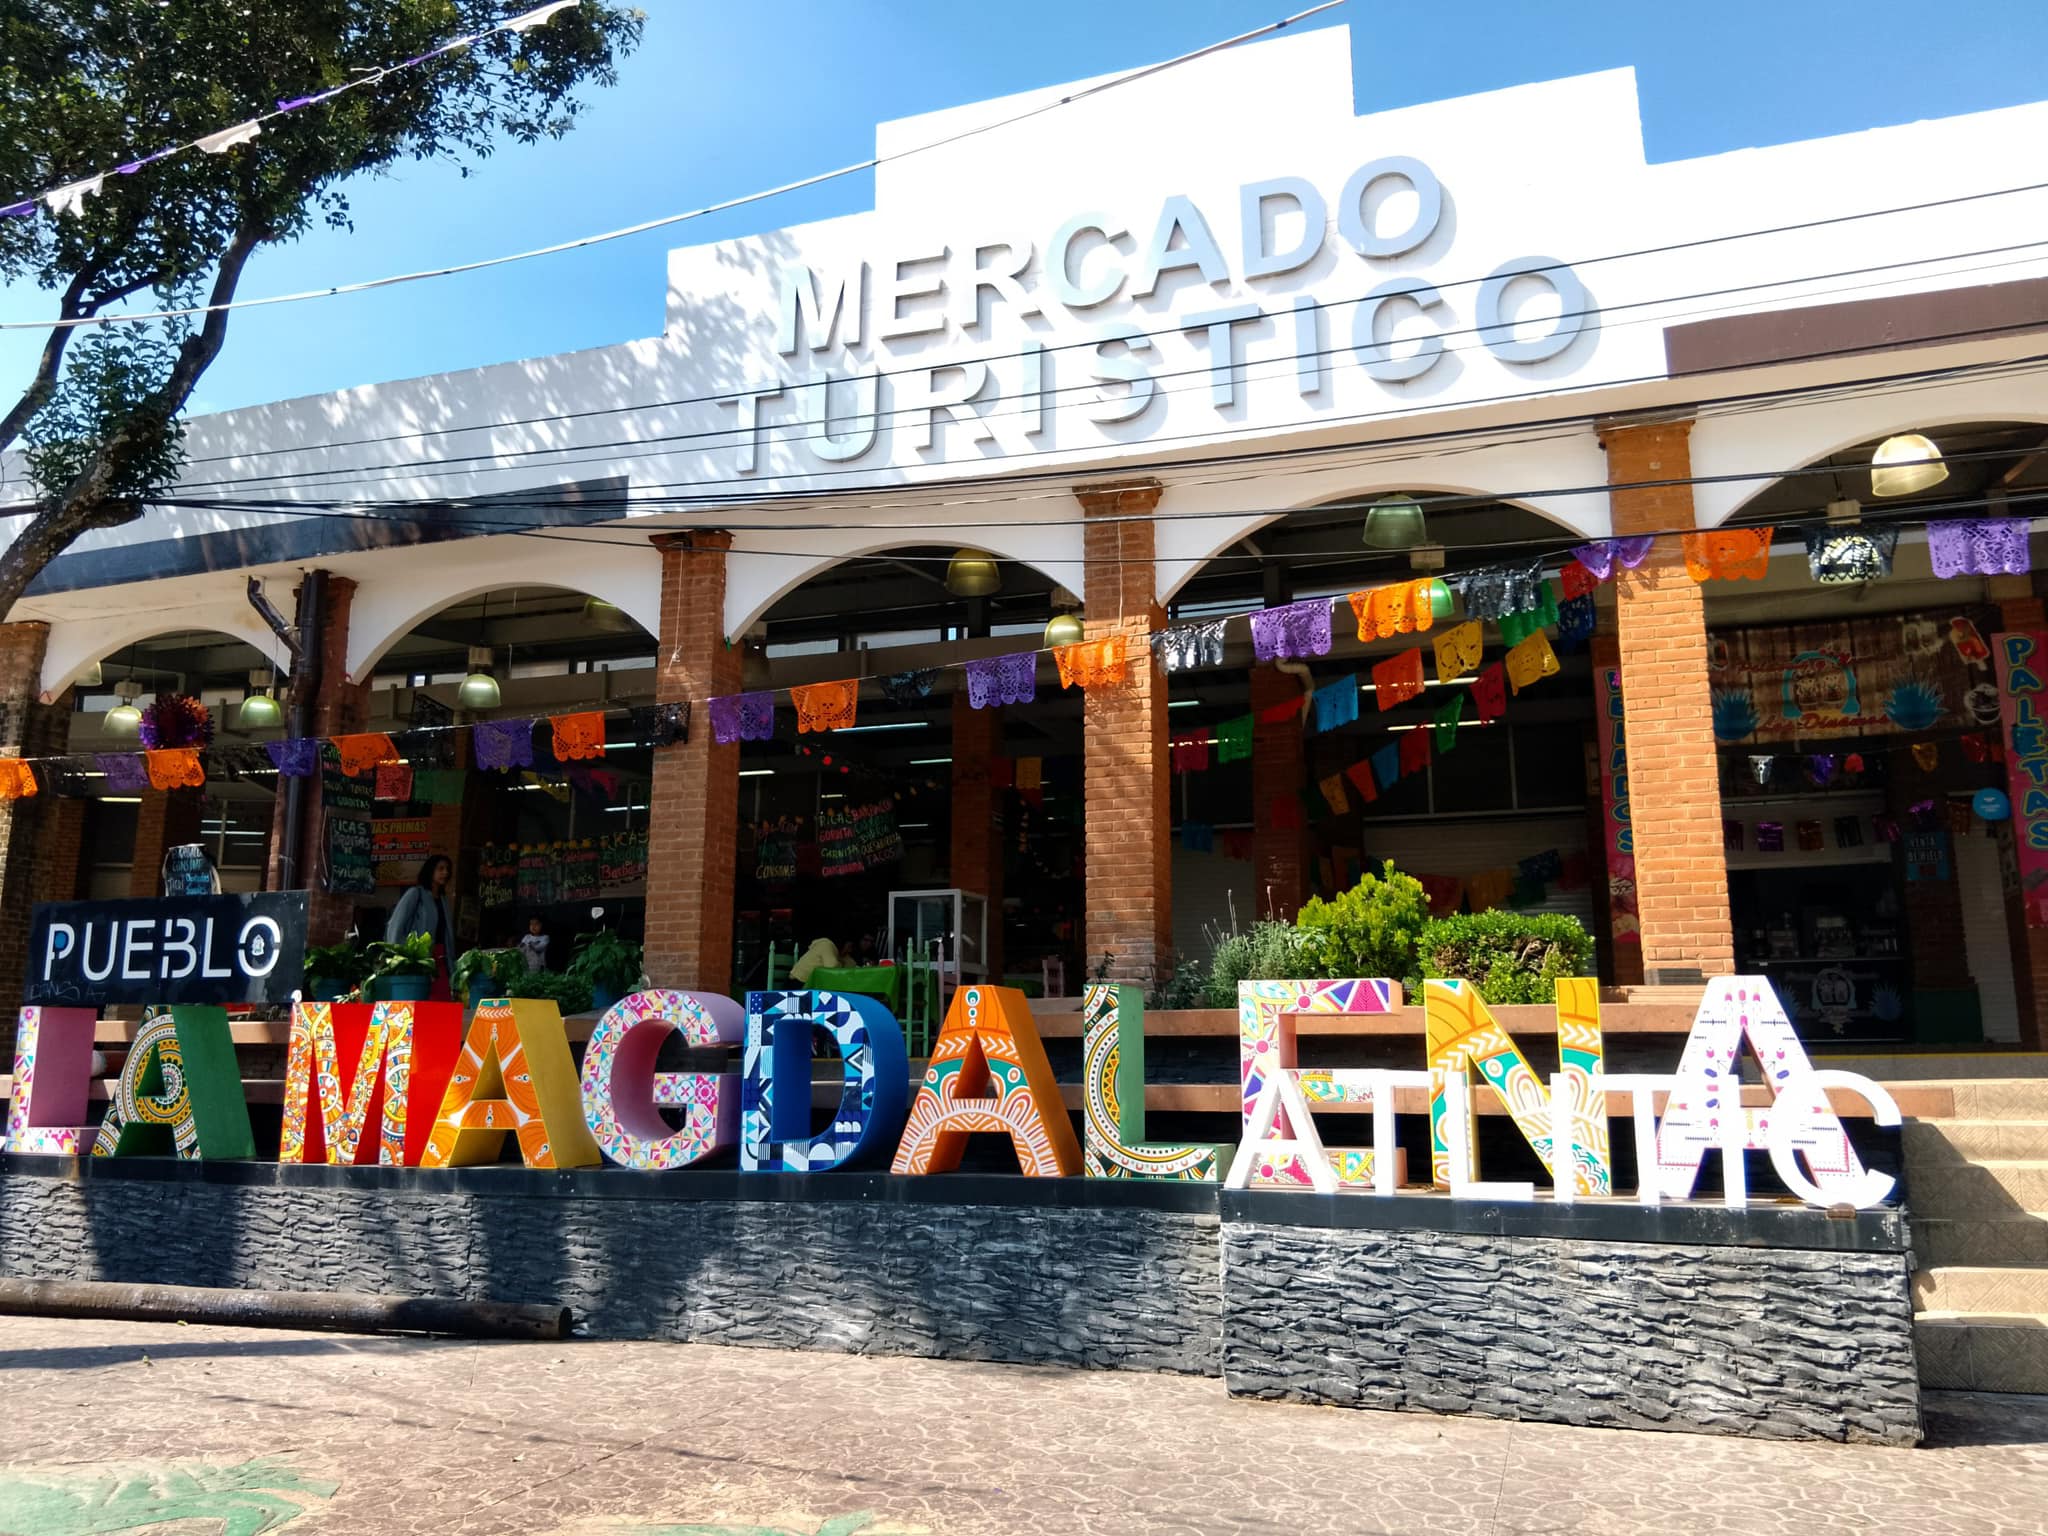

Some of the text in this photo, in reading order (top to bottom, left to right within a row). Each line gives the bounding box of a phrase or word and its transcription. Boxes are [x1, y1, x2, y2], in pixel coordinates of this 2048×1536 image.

[777, 155, 1443, 357] MERCADO
[715, 255, 1587, 475] TURISTICO
[388, 820, 427, 834] PRIMAS
[43, 914, 282, 982] PUEBLO
[4, 1004, 256, 1160] LA
[1222, 1068, 1902, 1211] ATLITIC
